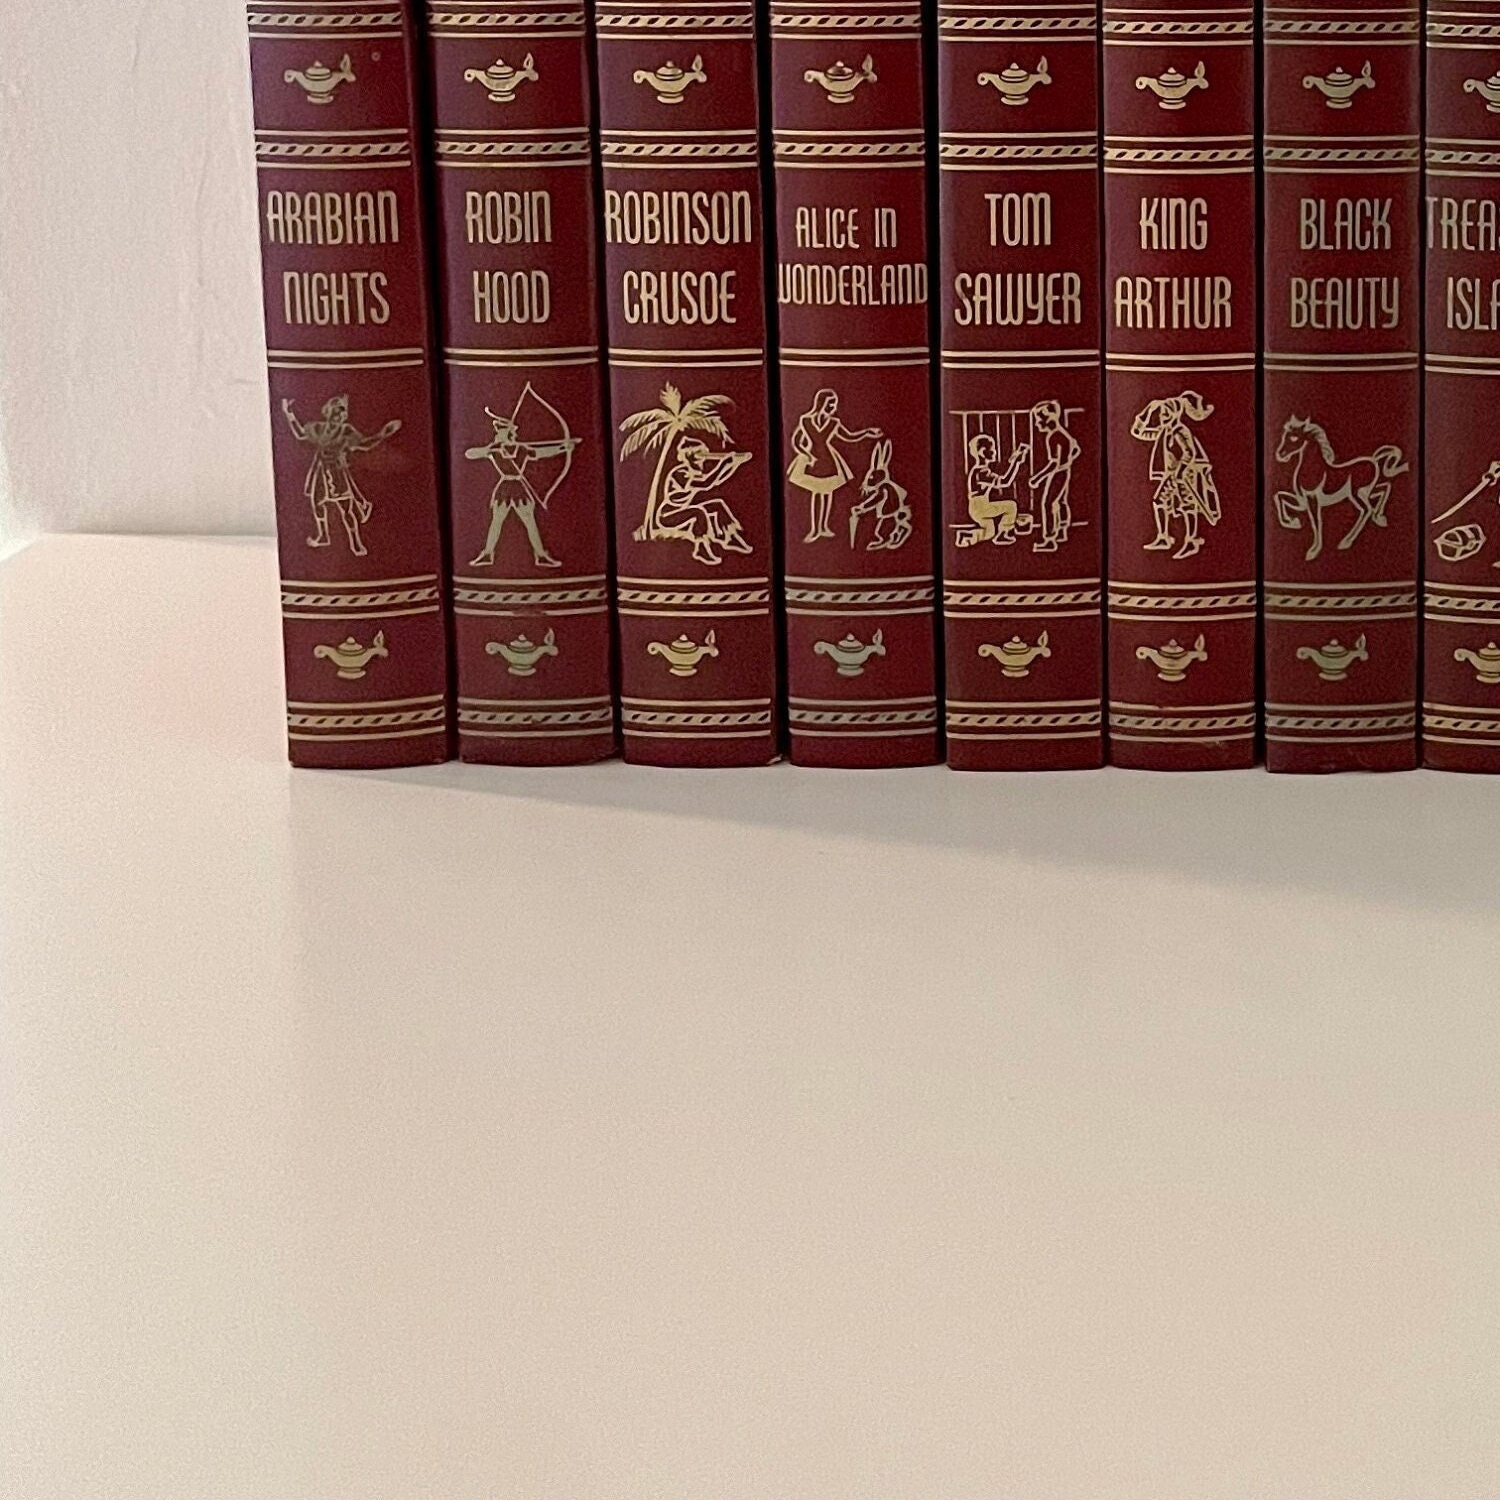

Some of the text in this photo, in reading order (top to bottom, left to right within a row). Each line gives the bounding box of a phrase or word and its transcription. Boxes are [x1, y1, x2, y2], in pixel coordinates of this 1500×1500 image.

[266, 191, 398, 244] ARABIAN
[465, 191, 551, 244] ROBIN
[604, 190, 751, 244] ROBINSON
[796, 207, 896, 248] ALICE IN
[985, 193, 1050, 246] TOM
[1140, 198, 1207, 249] KING
[1301, 199, 1391, 250] BLACK
[283, 272, 389, 325] NIGHTS
[473, 271, 549, 323] HOOD
[624, 271, 736, 324] CRUSOE
[955, 273, 1080, 325] SAWYER
[1114, 277, 1231, 328] ARTHUR
[1291, 278, 1398, 329] BEAUTY
